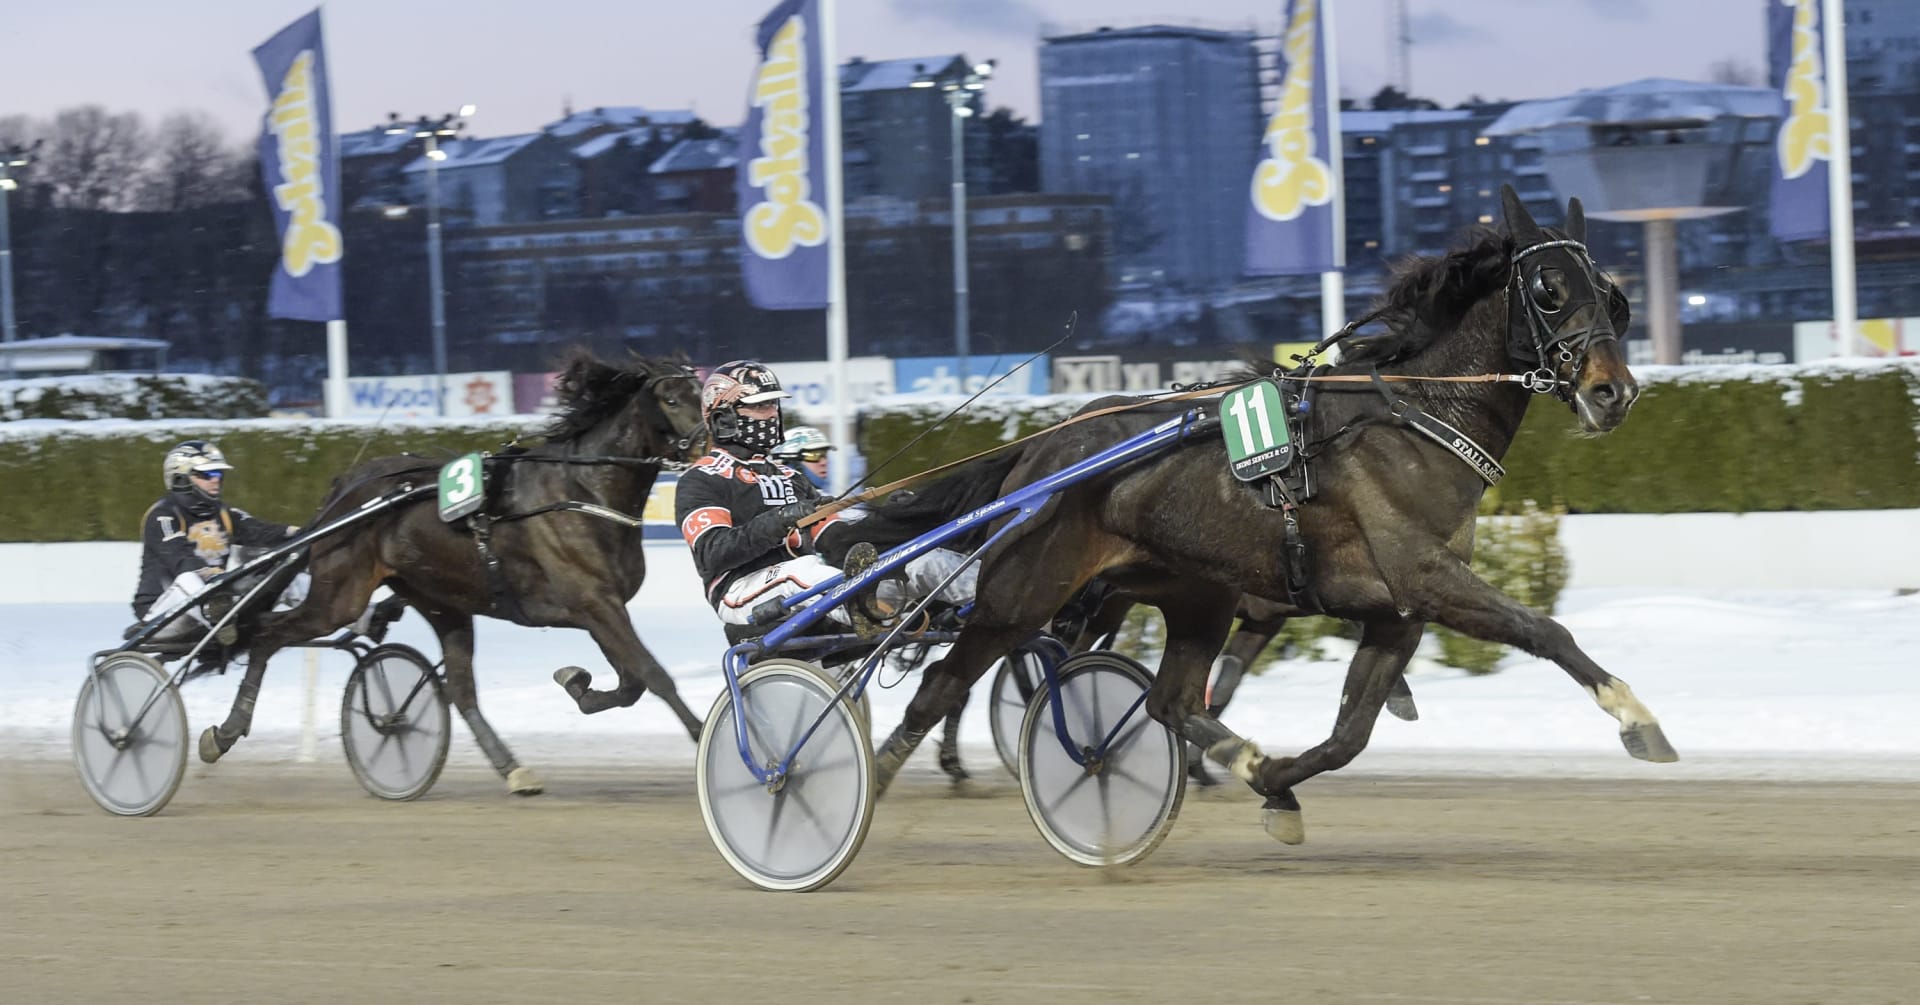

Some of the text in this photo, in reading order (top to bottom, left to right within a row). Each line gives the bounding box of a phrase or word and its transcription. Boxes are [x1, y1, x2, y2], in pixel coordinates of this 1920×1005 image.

[743, 14, 828, 259] Solvalla
[1229, 385, 1275, 456] 11
[447, 458, 475, 503] 3
[1452, 438, 1484, 466] STALL
